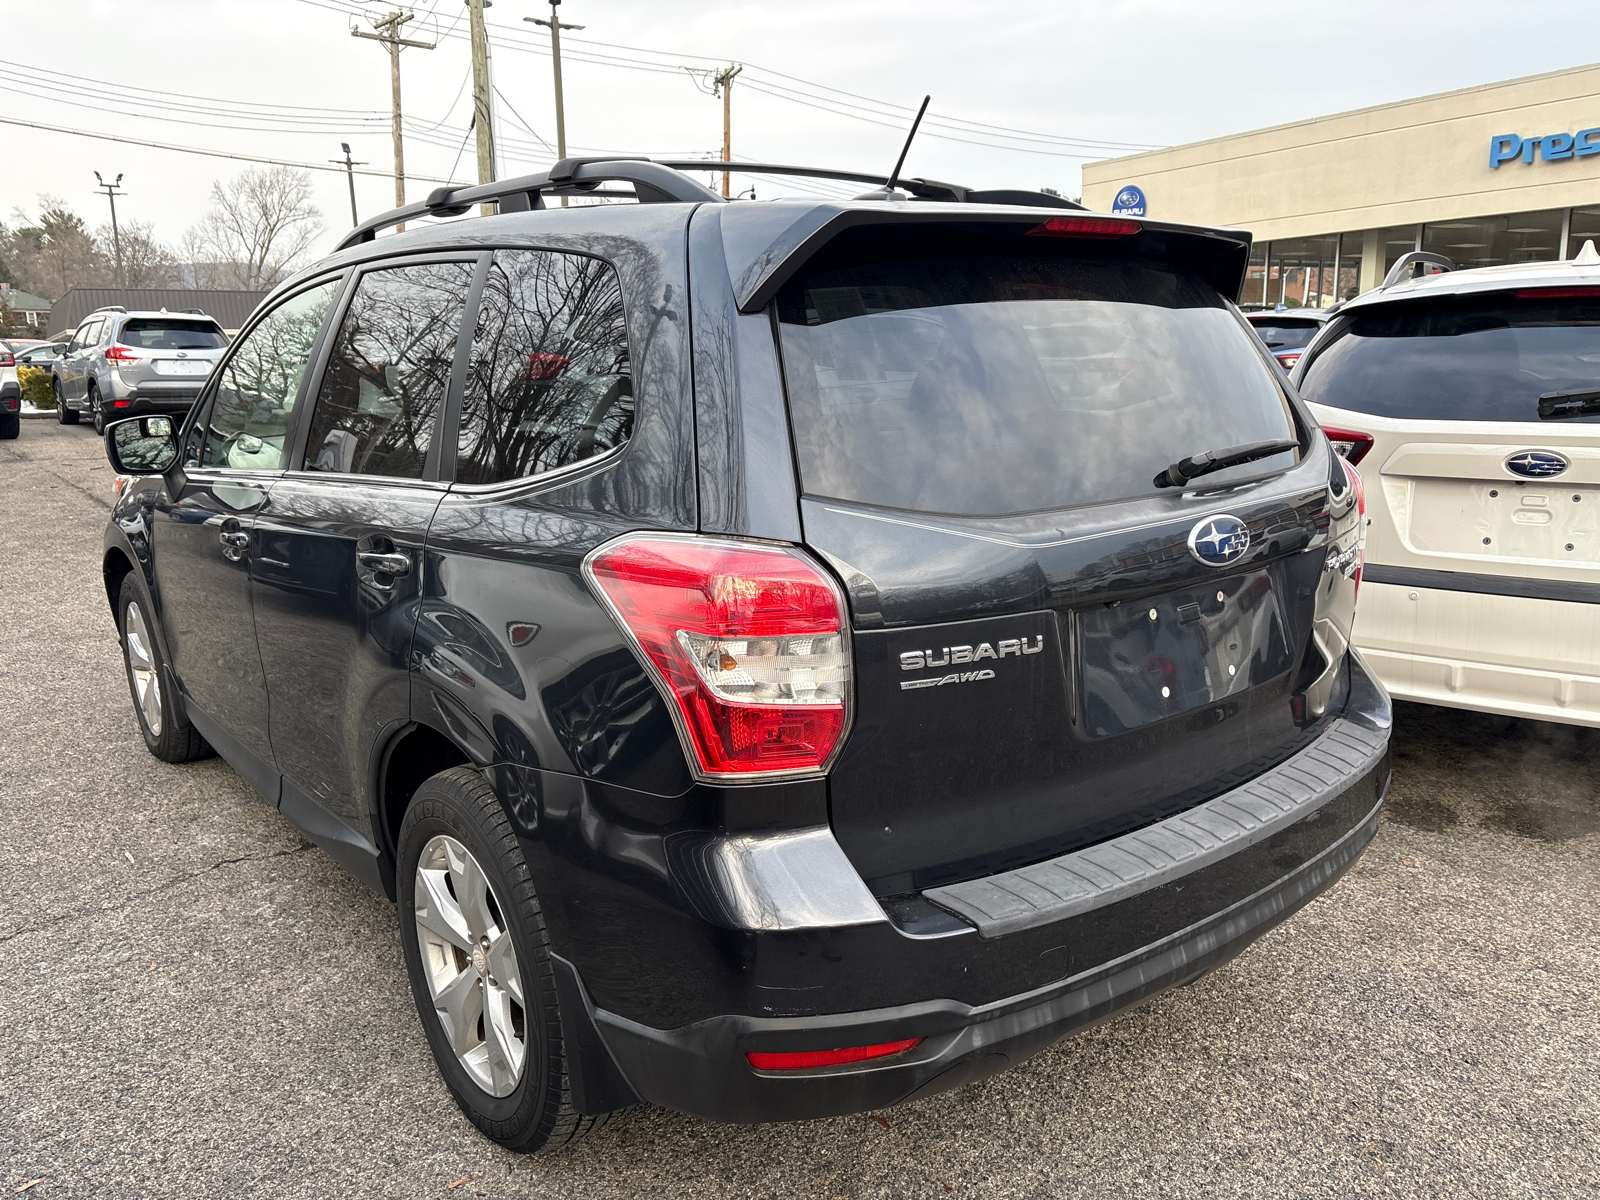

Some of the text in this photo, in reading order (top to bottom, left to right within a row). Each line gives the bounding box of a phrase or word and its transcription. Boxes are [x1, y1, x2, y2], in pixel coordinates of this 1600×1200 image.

[1489, 127, 1600, 168] Pres
[1113, 207, 1144, 216] SUBARU
[899, 634, 1044, 671] SUBARU
[937, 669, 996, 686] AWD
